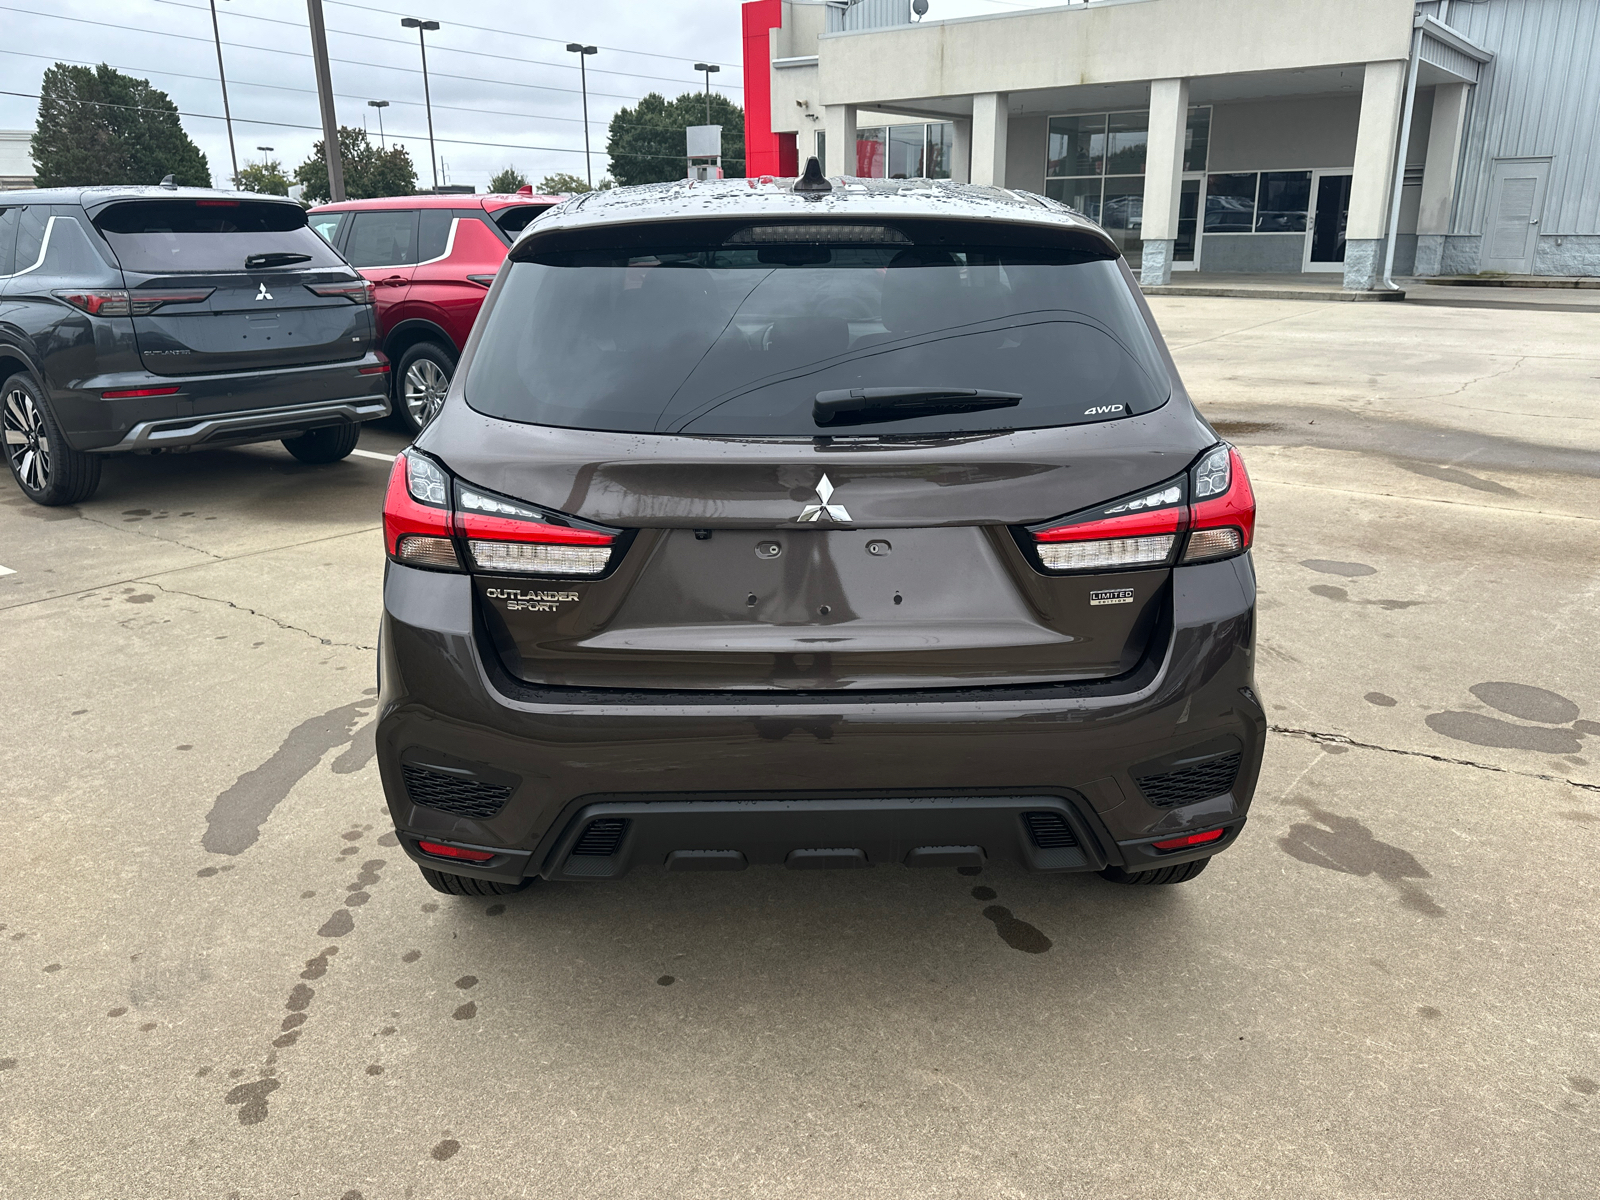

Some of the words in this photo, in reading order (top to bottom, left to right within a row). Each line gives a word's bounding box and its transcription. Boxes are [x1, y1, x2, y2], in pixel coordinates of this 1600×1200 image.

[1083, 404, 1124, 415] 4WD
[486, 588, 580, 602] OUTLANDER
[1092, 591, 1132, 600] LIMITED
[506, 600, 560, 612] SPORT
